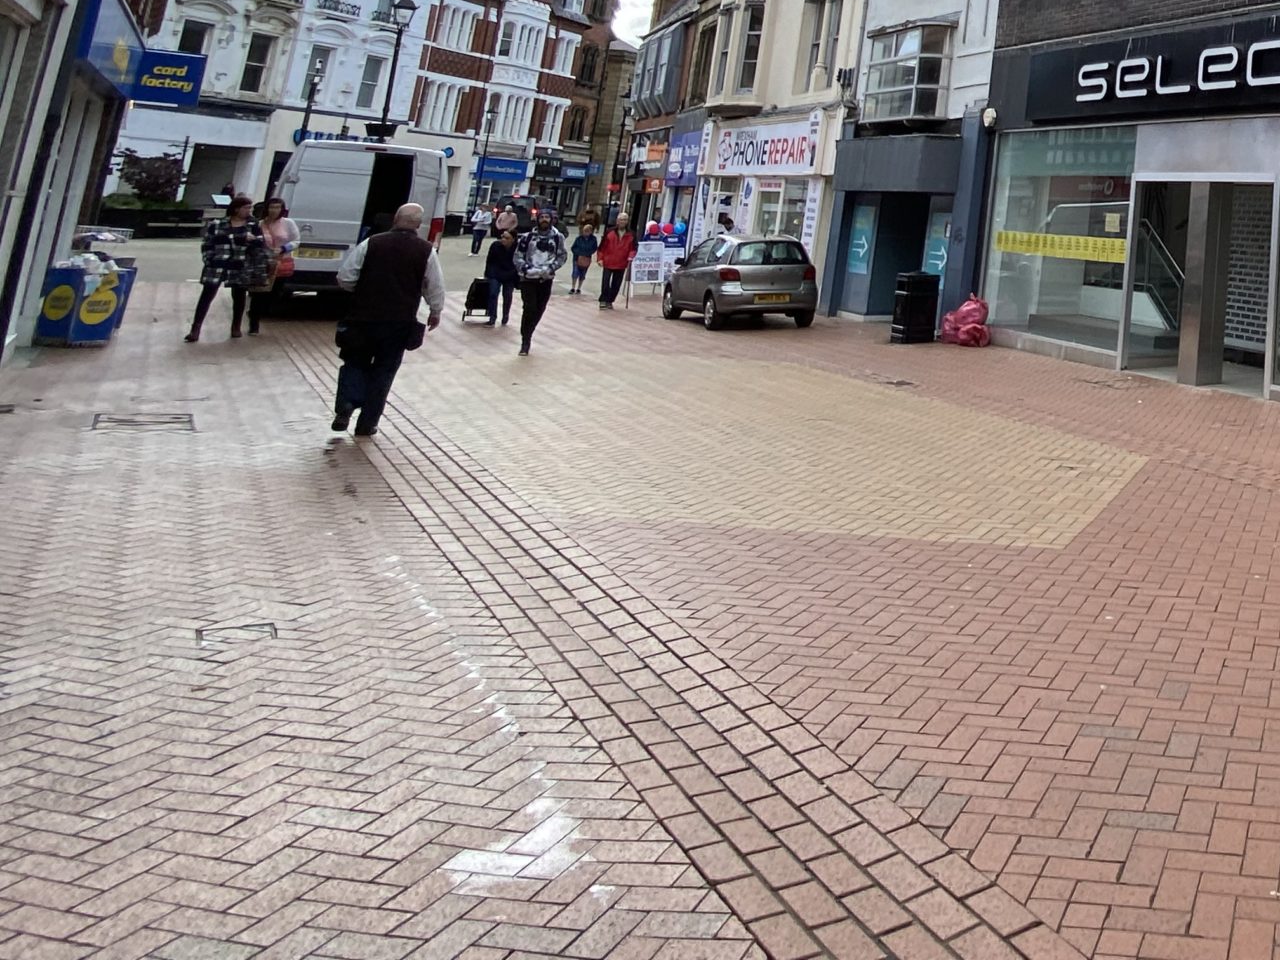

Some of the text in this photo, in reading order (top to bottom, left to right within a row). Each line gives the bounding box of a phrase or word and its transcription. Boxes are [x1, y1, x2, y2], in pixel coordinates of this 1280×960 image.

[153, 66, 188, 76] card
[141, 75, 194, 92] factory
[731, 139, 769, 166] PHONE
[767, 136, 807, 165] REPAIR
